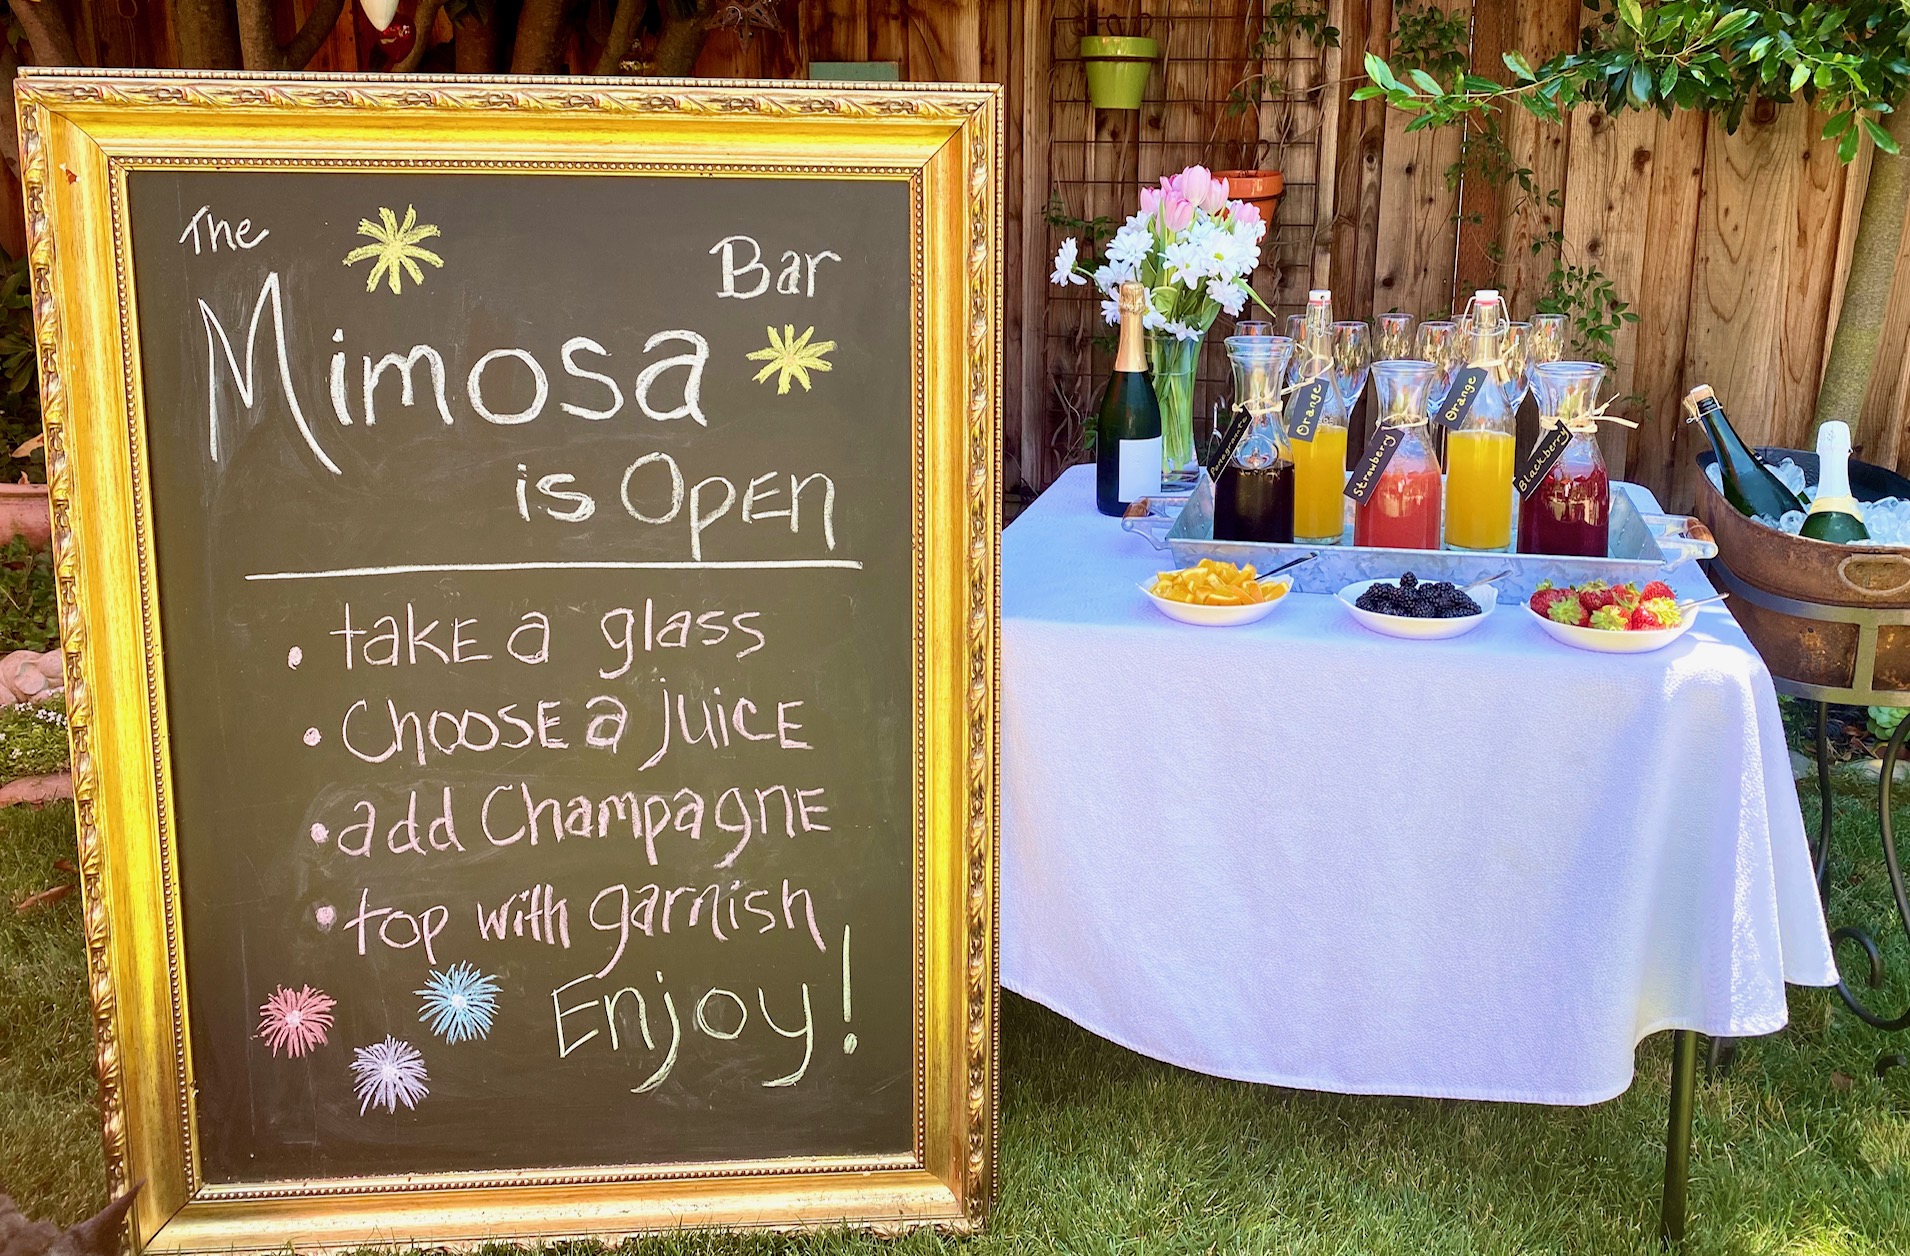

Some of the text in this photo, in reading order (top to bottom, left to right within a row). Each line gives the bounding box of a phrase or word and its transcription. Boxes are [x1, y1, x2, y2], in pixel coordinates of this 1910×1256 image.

[180, 205, 269, 254] The
[708, 234, 843, 299] Bar
[198, 271, 710, 476] Mimosa
[1445, 375, 1476, 422] Orange
[1296, 383, 1322, 436] Orange
[1353, 434, 1396, 497] Strawberry
[1518, 426, 1568, 493] Blackberry
[514, 463, 597, 522] is
[506, 611, 550, 664] a
[599, 598, 765, 679] glass
[584, 694, 629, 752] a
[336, 786, 465, 857] add
[343, 878, 827, 979] top with garnish
[550, 924, 858, 1094] Enjoy!
